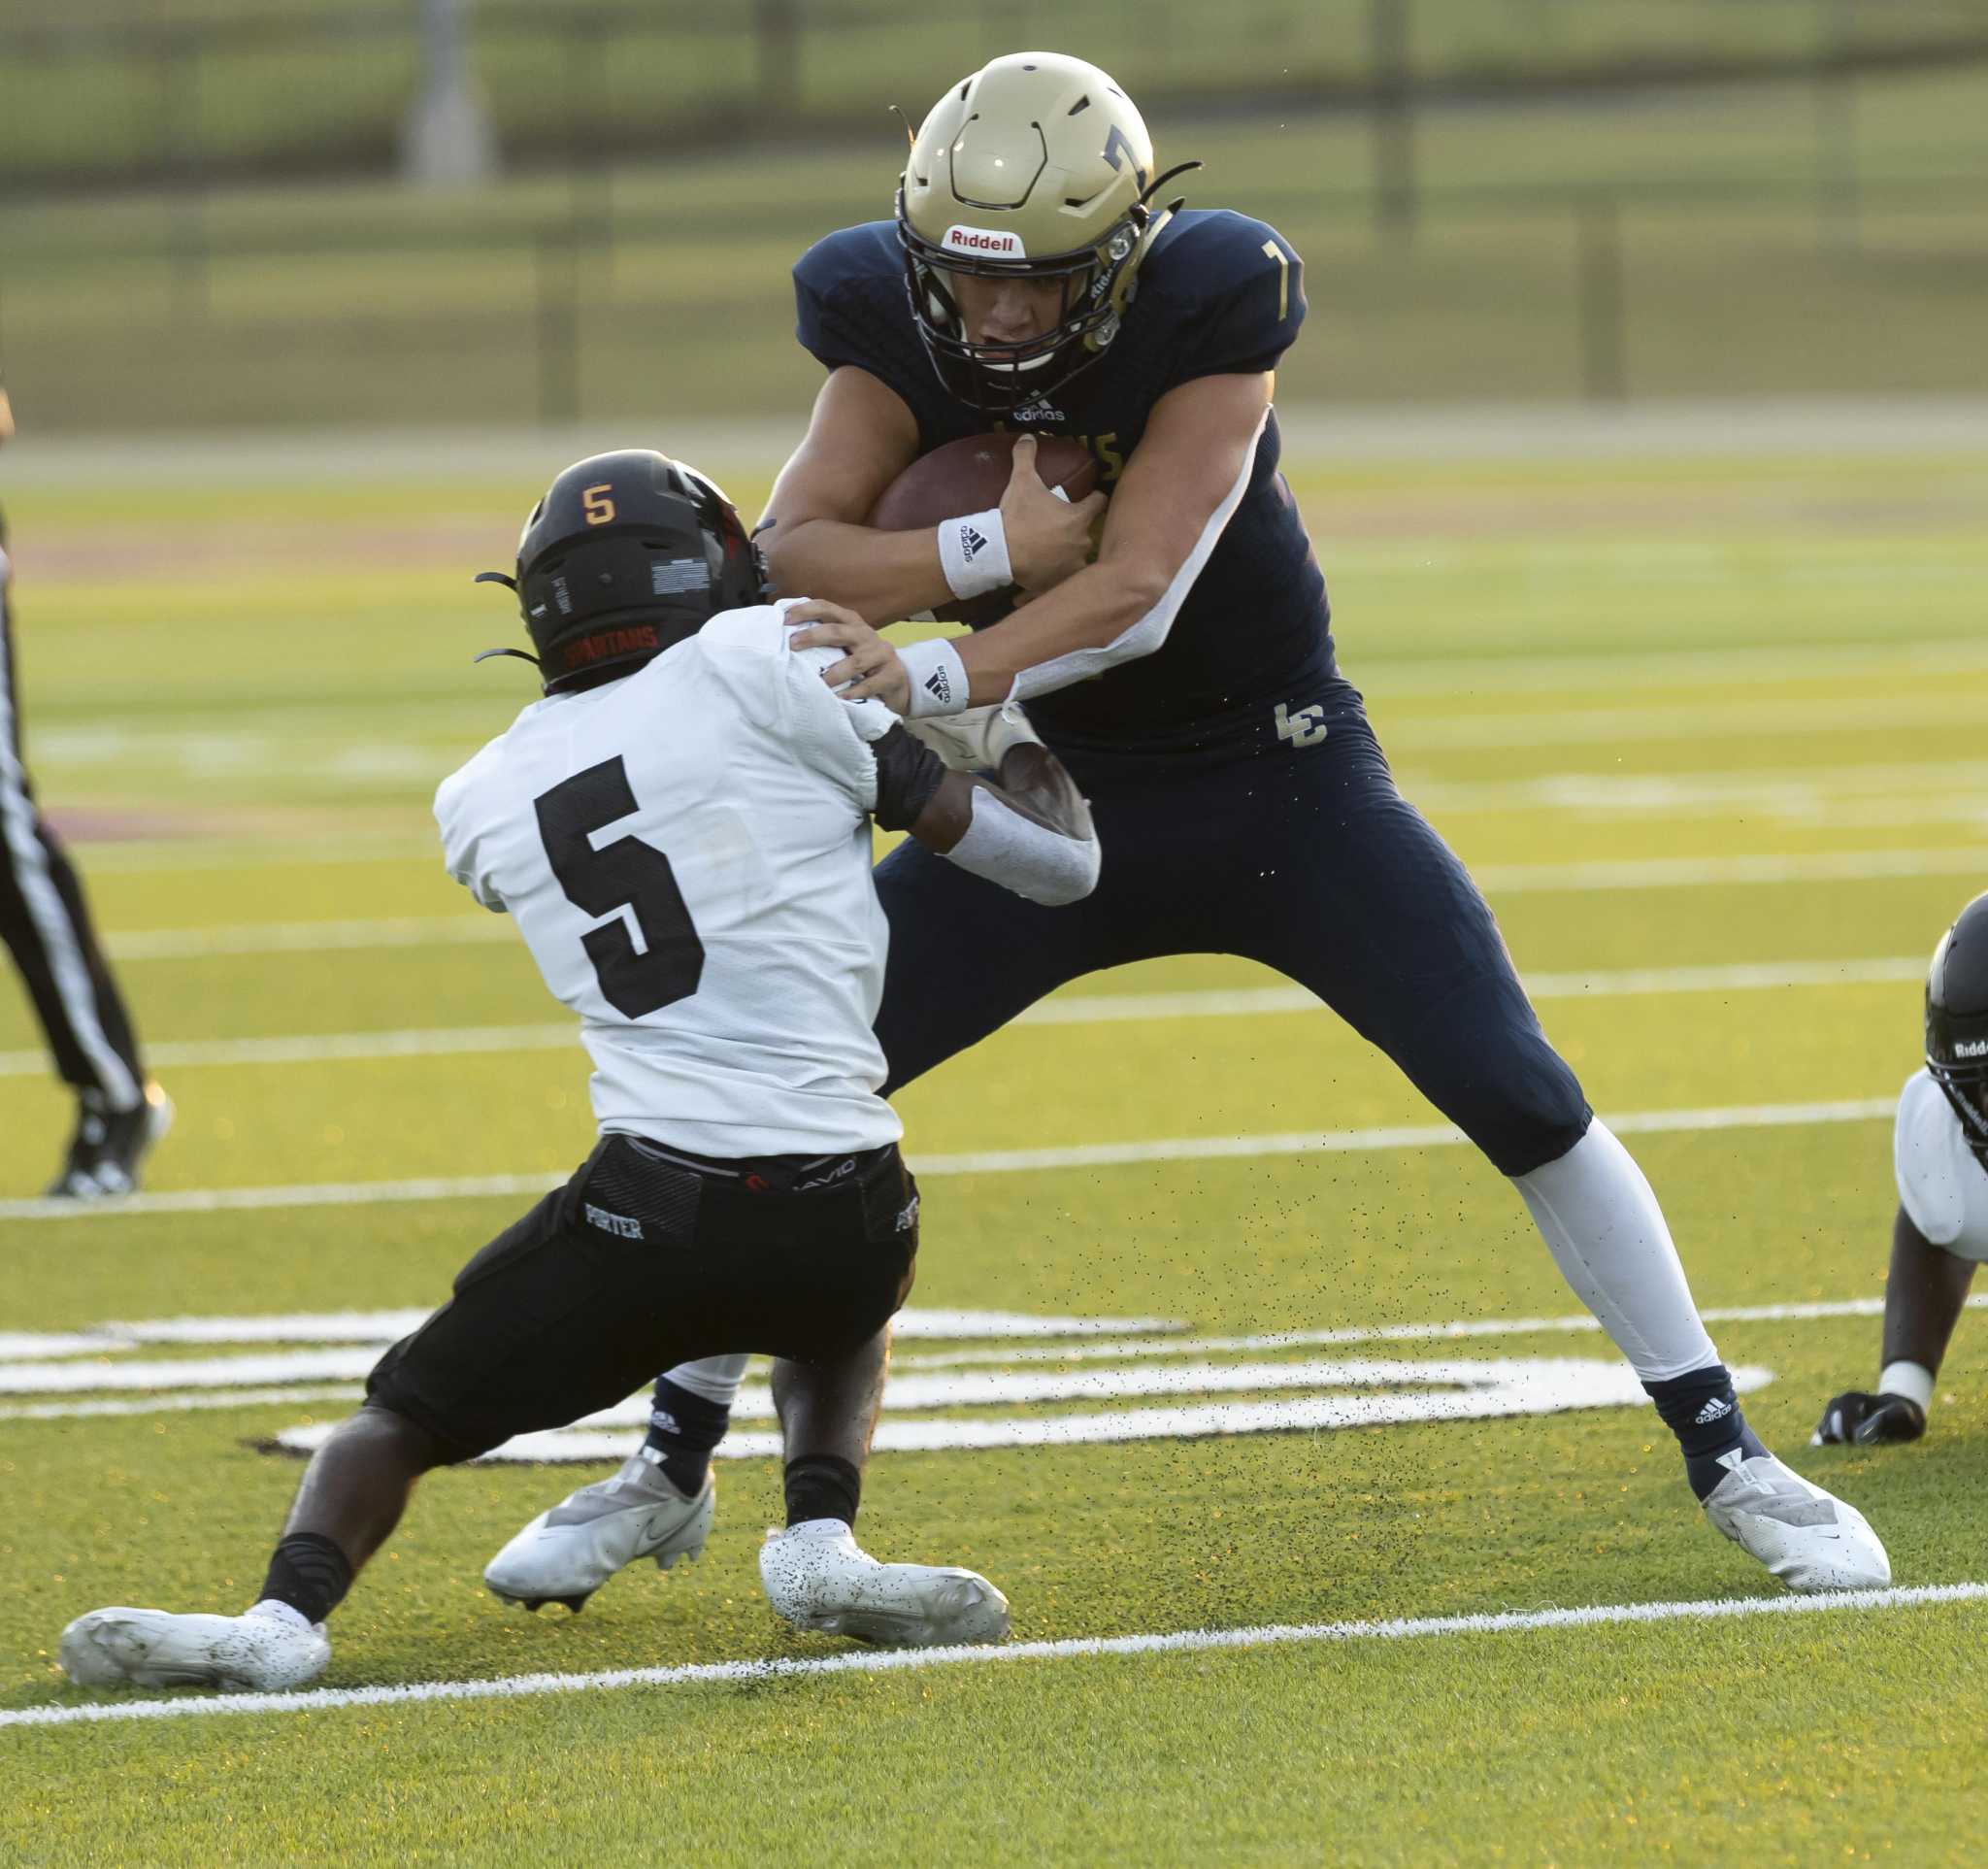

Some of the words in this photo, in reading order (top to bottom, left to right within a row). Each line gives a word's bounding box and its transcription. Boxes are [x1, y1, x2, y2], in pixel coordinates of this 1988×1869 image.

[951, 229, 1013, 251] Riddell
[1261, 240, 1289, 321] 7
[1013, 409, 1066, 421] adidas
[582, 484, 616, 525] 5
[960, 525, 974, 563] adidas
[565, 625, 659, 668] SPARTANS
[937, 665, 951, 704] adidas
[1274, 703, 1328, 748] LC
[533, 753, 707, 1020] 5
[1955, 1040, 1988, 1058] Ridd
[1695, 1404, 1733, 1424] adidas
